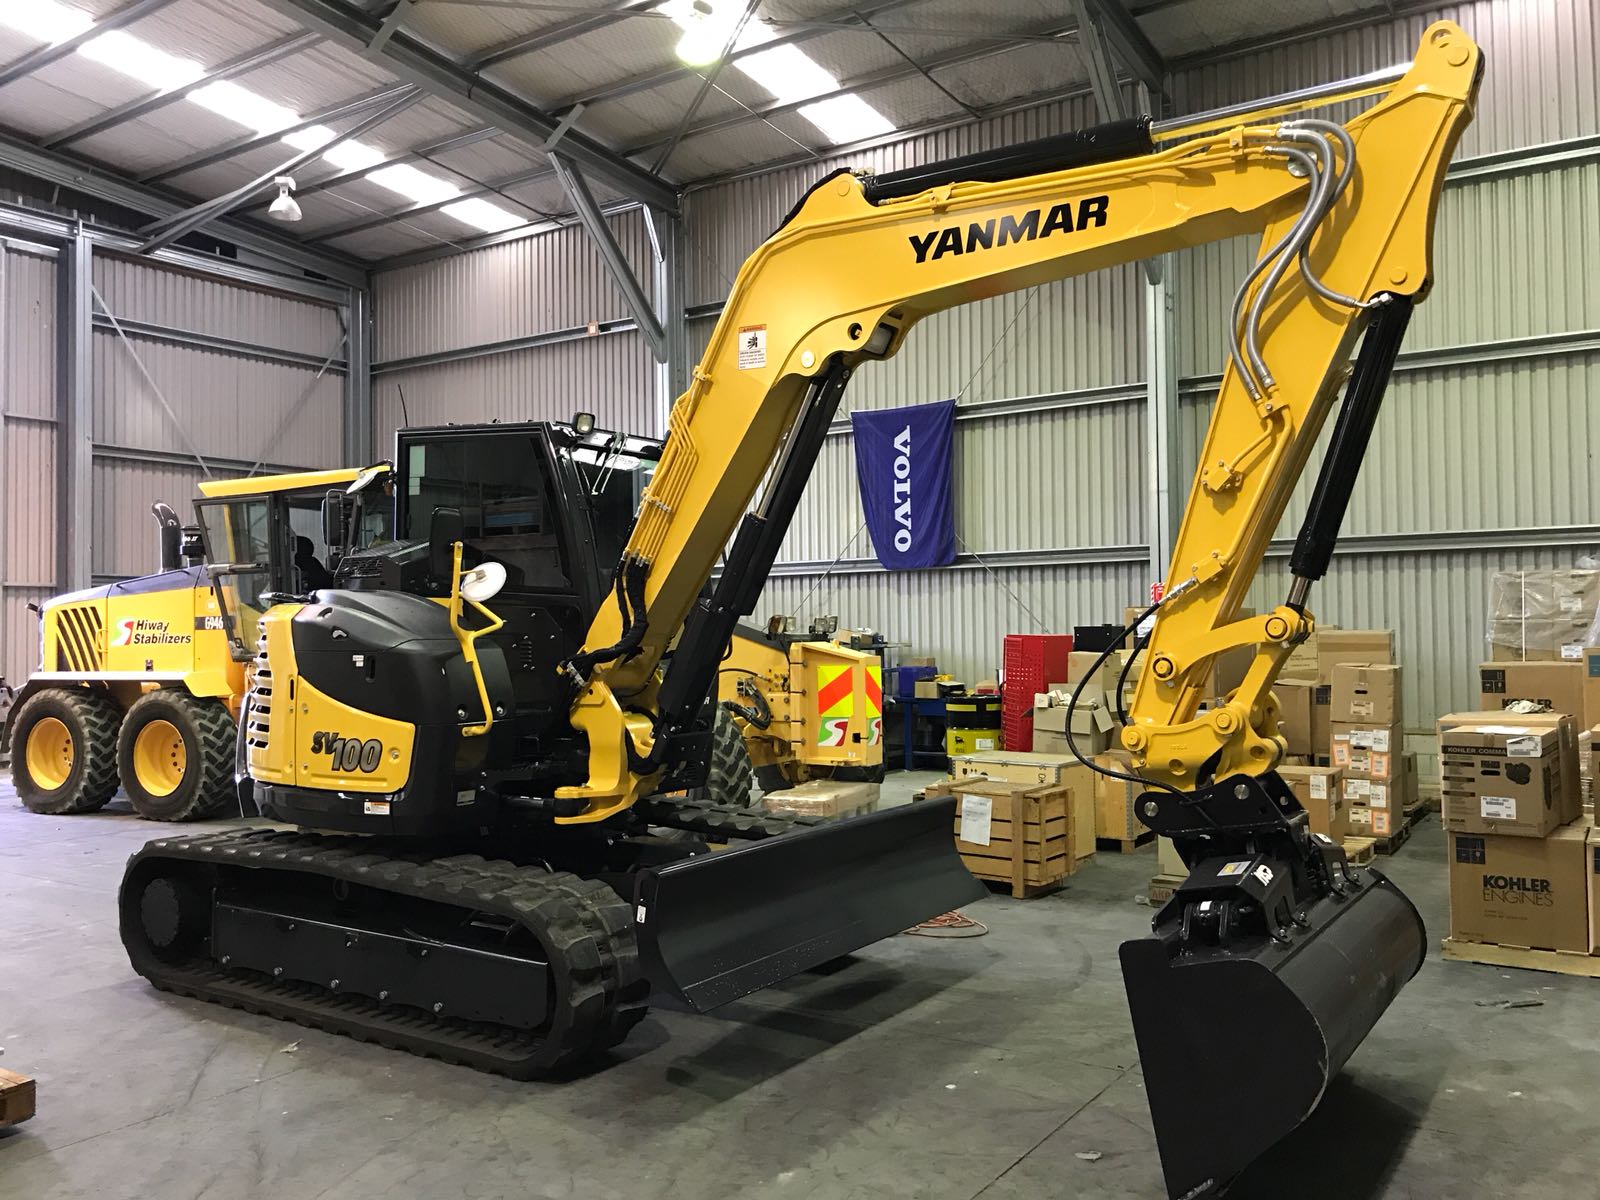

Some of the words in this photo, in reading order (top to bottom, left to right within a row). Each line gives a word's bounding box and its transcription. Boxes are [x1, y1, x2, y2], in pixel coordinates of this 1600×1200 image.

[908, 195, 1109, 264] YANMAR
[893, 424, 912, 553] VOLVO
[136, 619, 170, 633] Hiway
[204, 616, 224, 630] G946
[133, 633, 192, 645] Stabilizers
[1447, 746, 1476, 754] KOHLER
[1482, 874, 1552, 893] KOHLER
[1482, 888, 1554, 908] ENGINES
